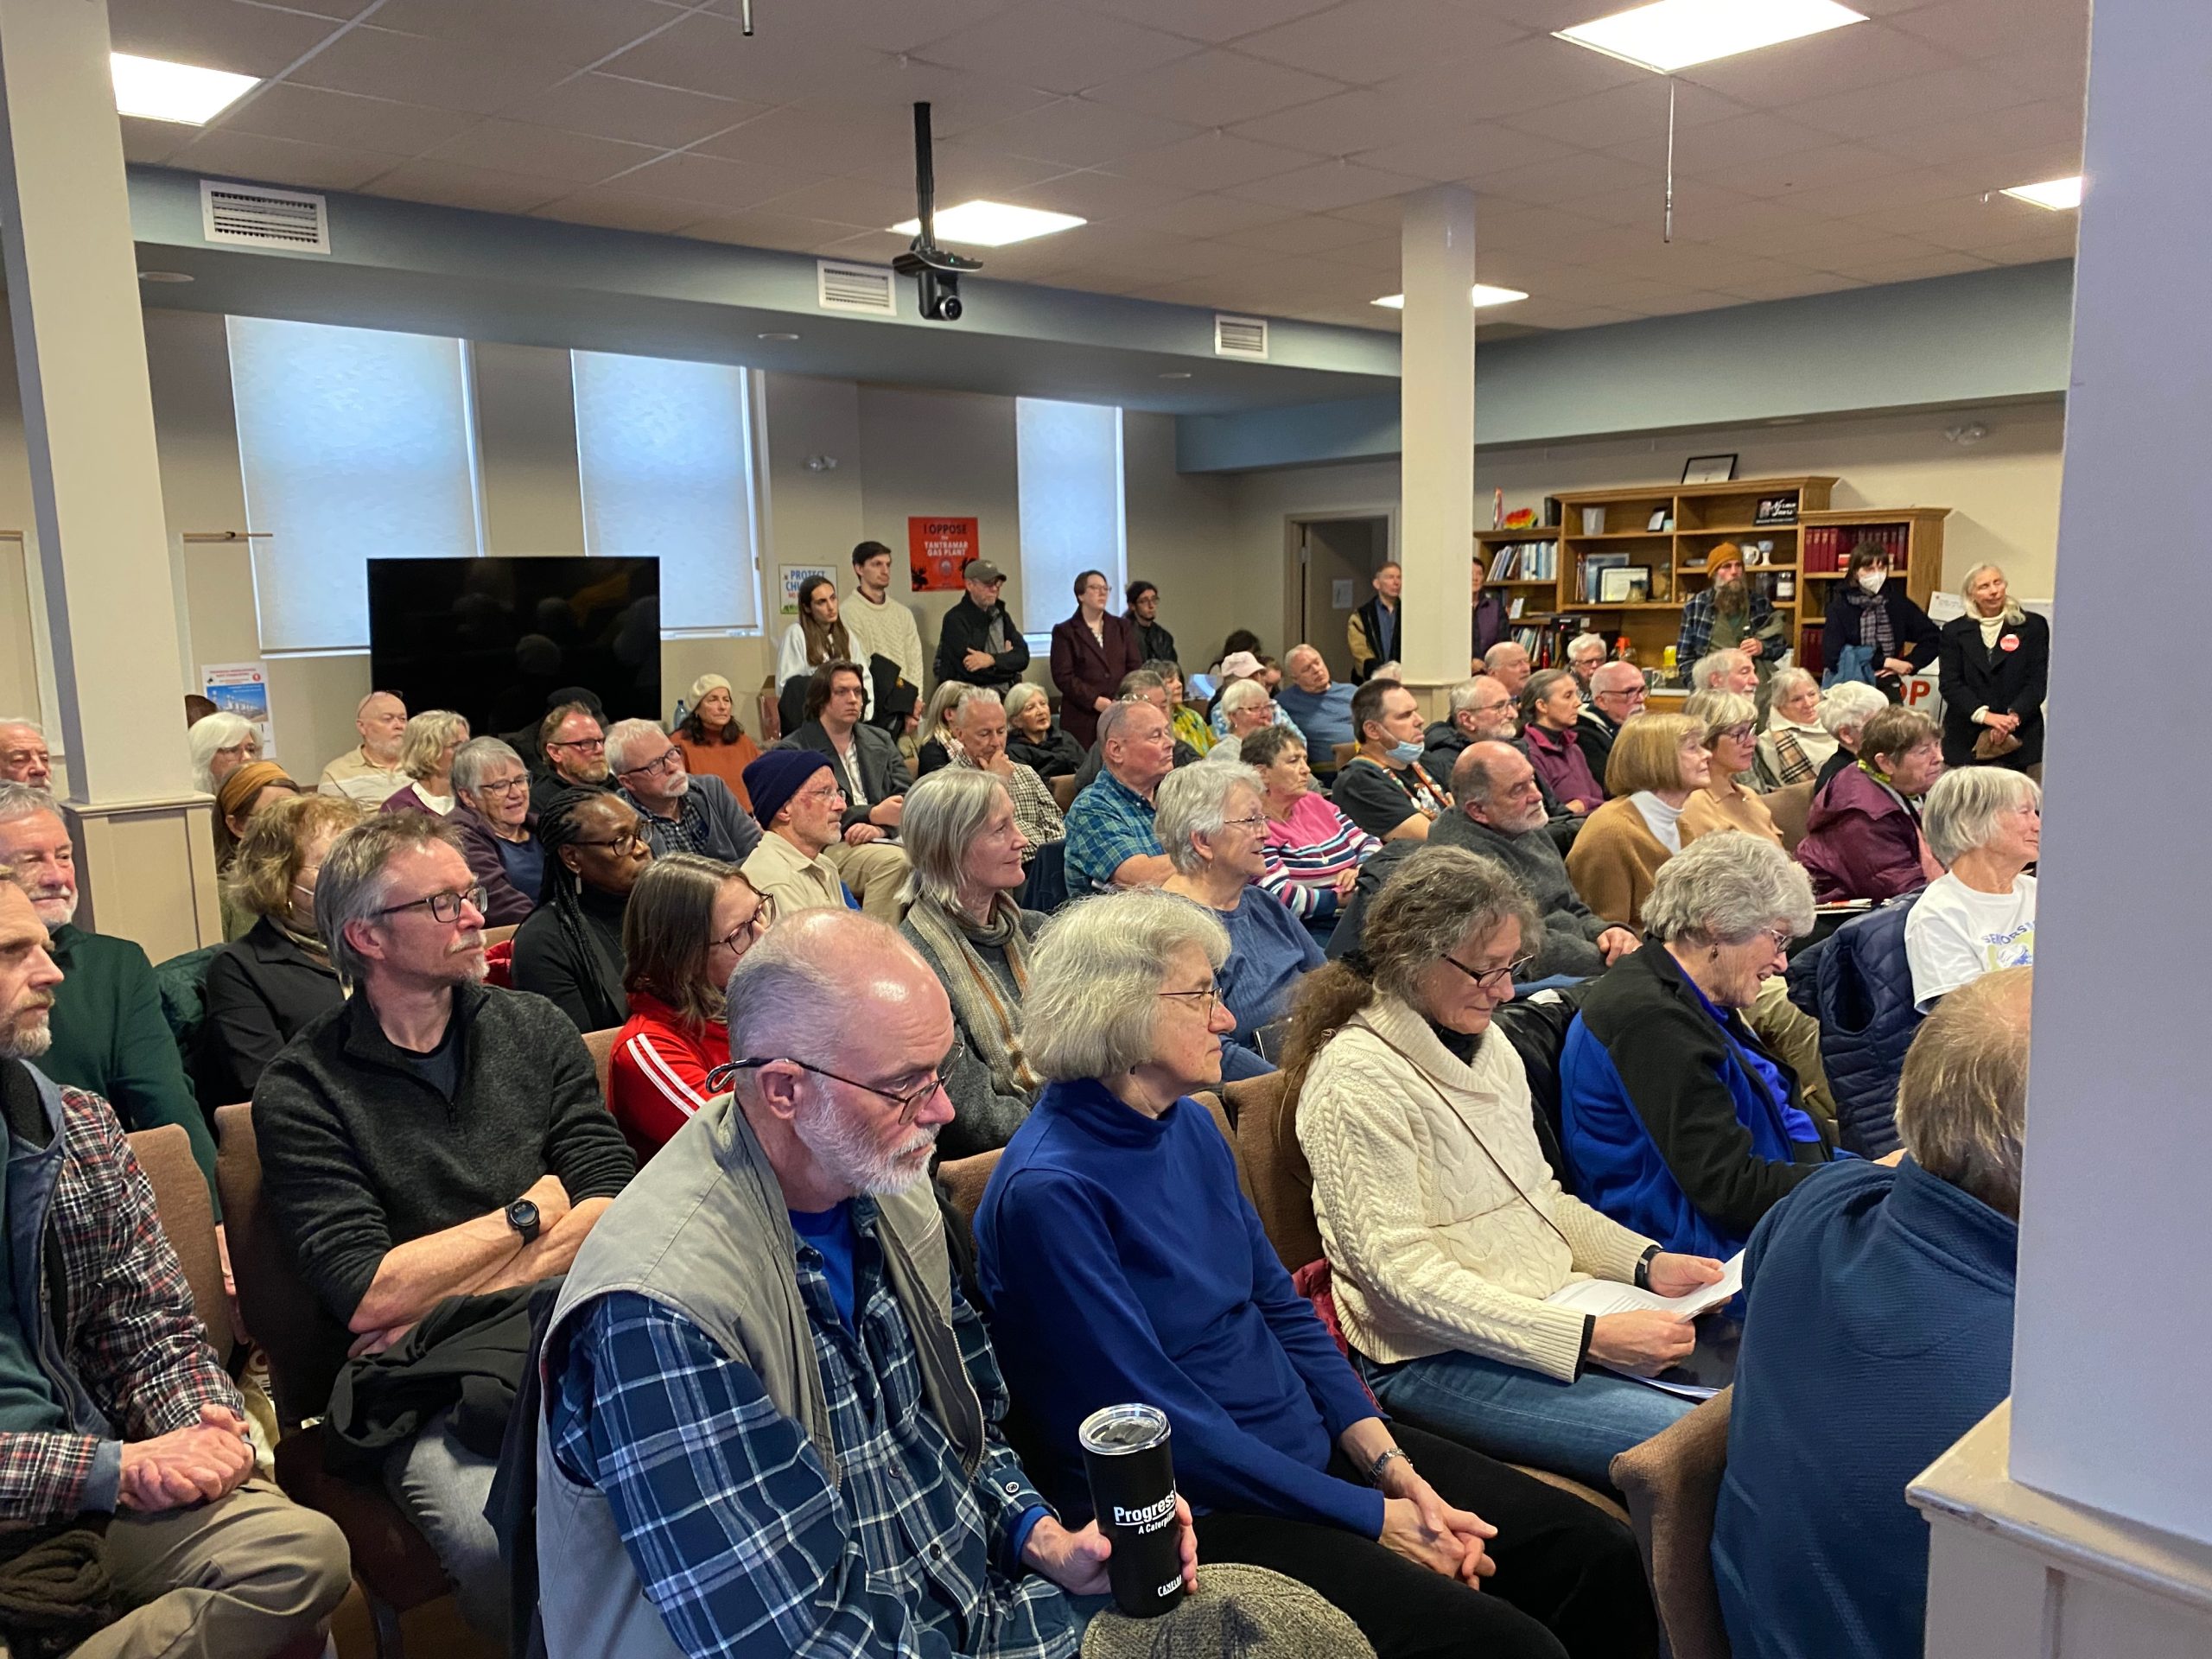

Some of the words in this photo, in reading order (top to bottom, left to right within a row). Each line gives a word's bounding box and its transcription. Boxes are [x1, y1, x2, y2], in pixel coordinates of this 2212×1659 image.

[929, 524, 968, 534] OPPOSE
[925, 541, 969, 550] TANTRAMAR
[927, 549, 942, 557] GAS
[1114, 1490, 1175, 1522] Progress
[1138, 1526, 1145, 1535] A
